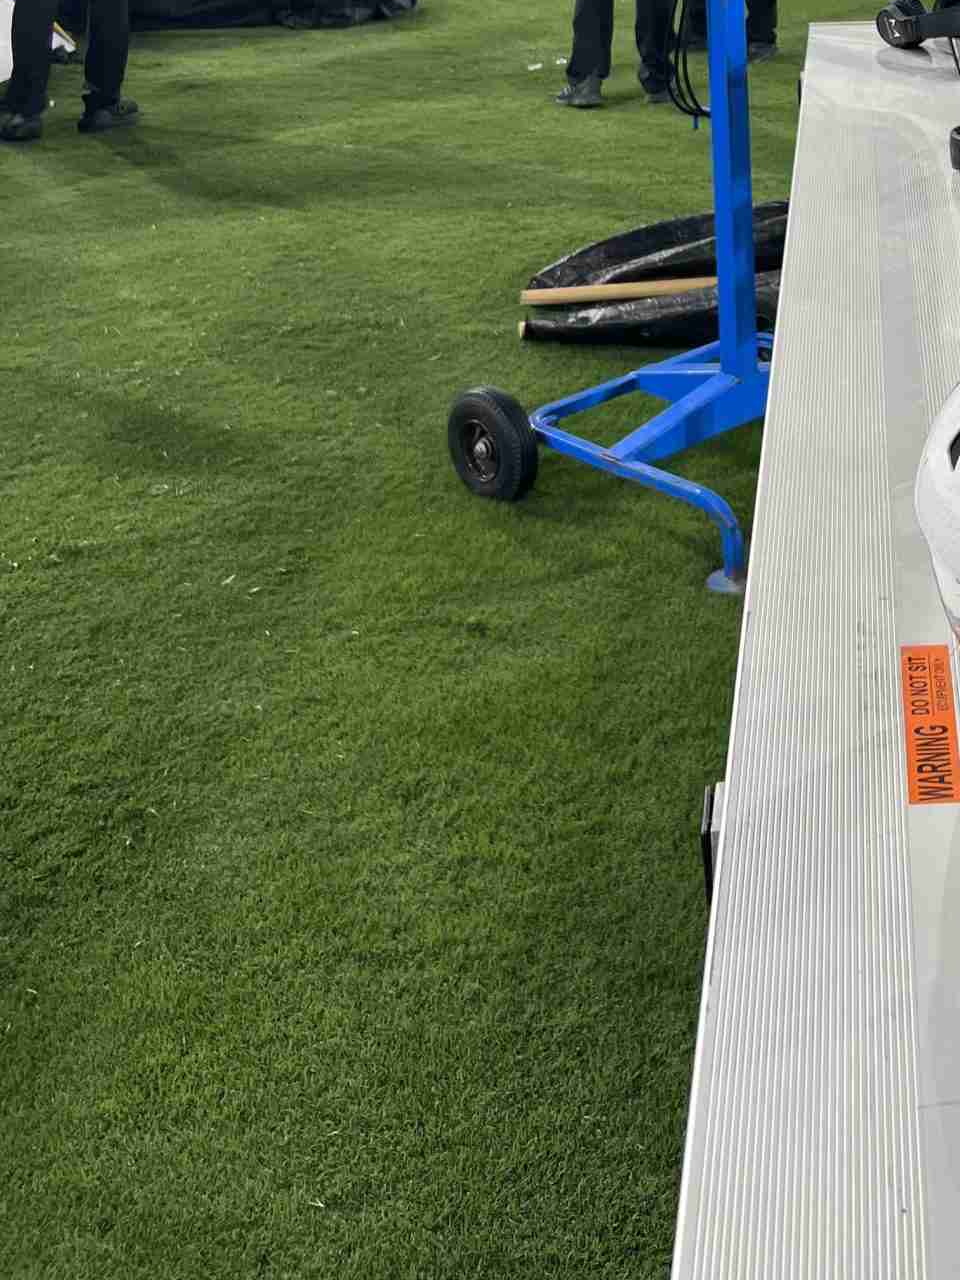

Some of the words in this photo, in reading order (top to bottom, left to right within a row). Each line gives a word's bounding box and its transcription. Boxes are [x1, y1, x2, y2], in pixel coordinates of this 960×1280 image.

[908, 656, 928, 672] SIT
[909, 674, 929, 698] NOT
[911, 699, 930, 716] DO
[914, 724, 954, 801] WARNING
